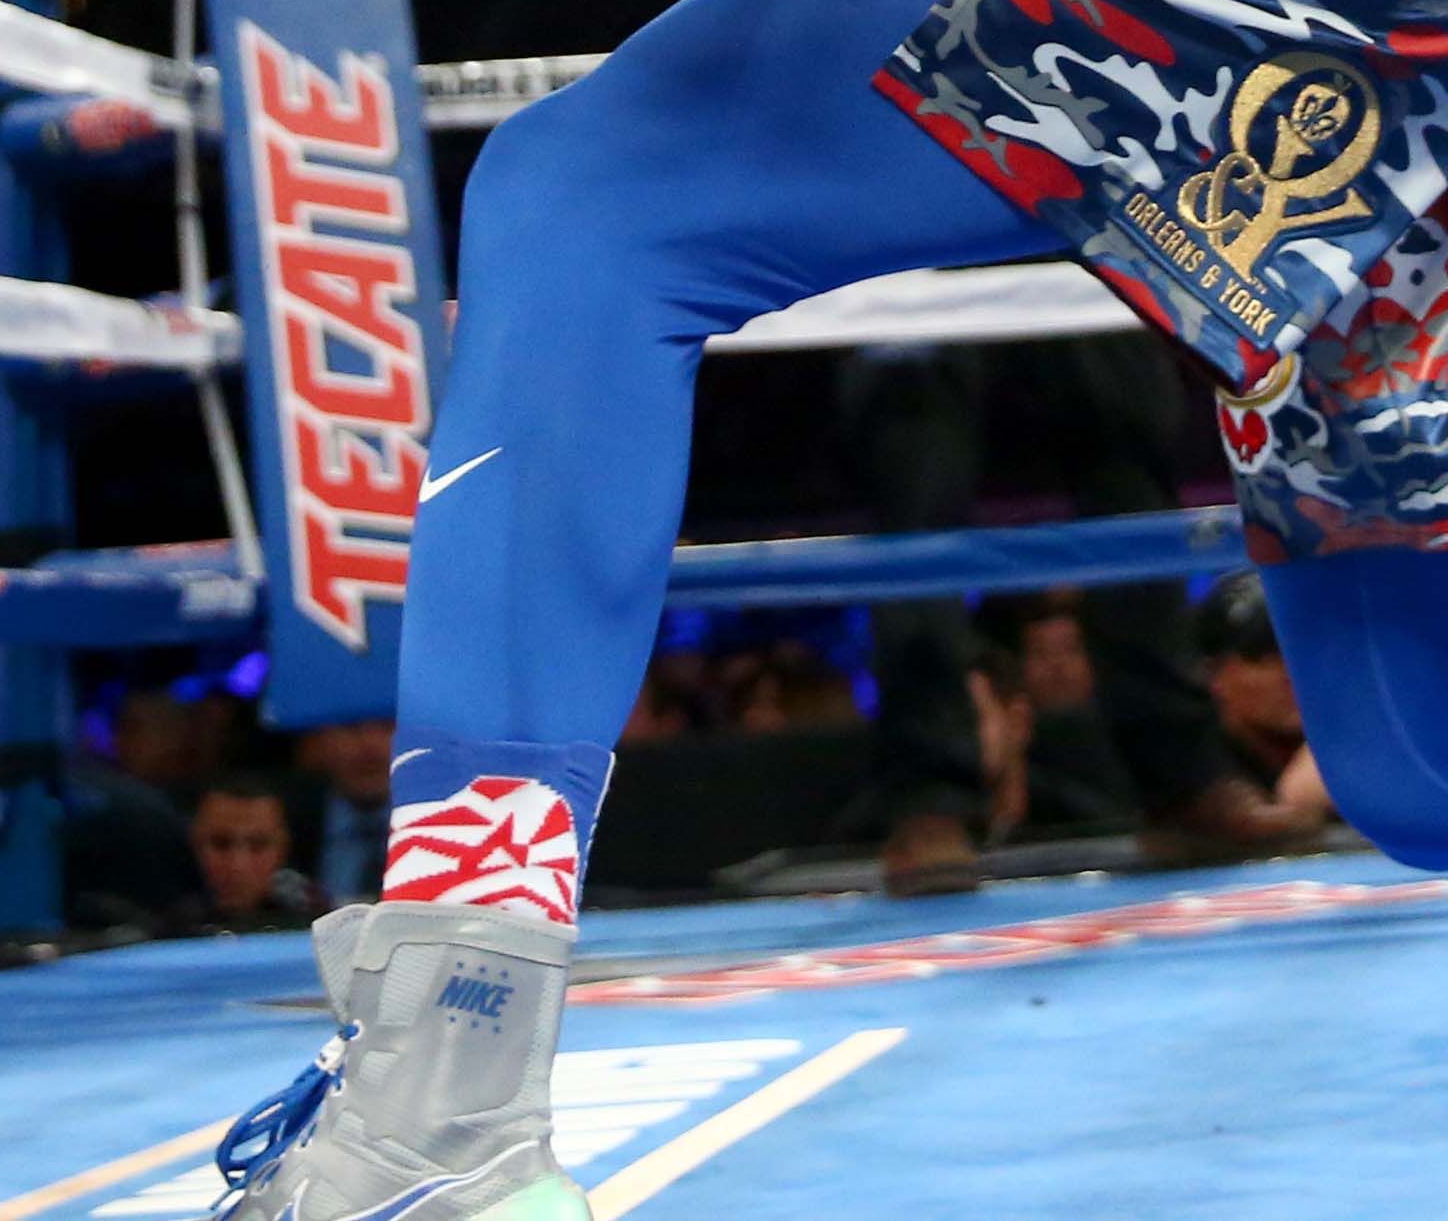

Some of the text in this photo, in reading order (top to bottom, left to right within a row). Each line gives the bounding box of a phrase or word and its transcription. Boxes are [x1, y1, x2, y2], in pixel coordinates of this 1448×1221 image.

[238, 16, 432, 651] TECATE
[1124, 191, 1206, 273] ORLEANS
[1218, 277, 1278, 337] YORK
[436, 975, 515, 1019] NIKE
